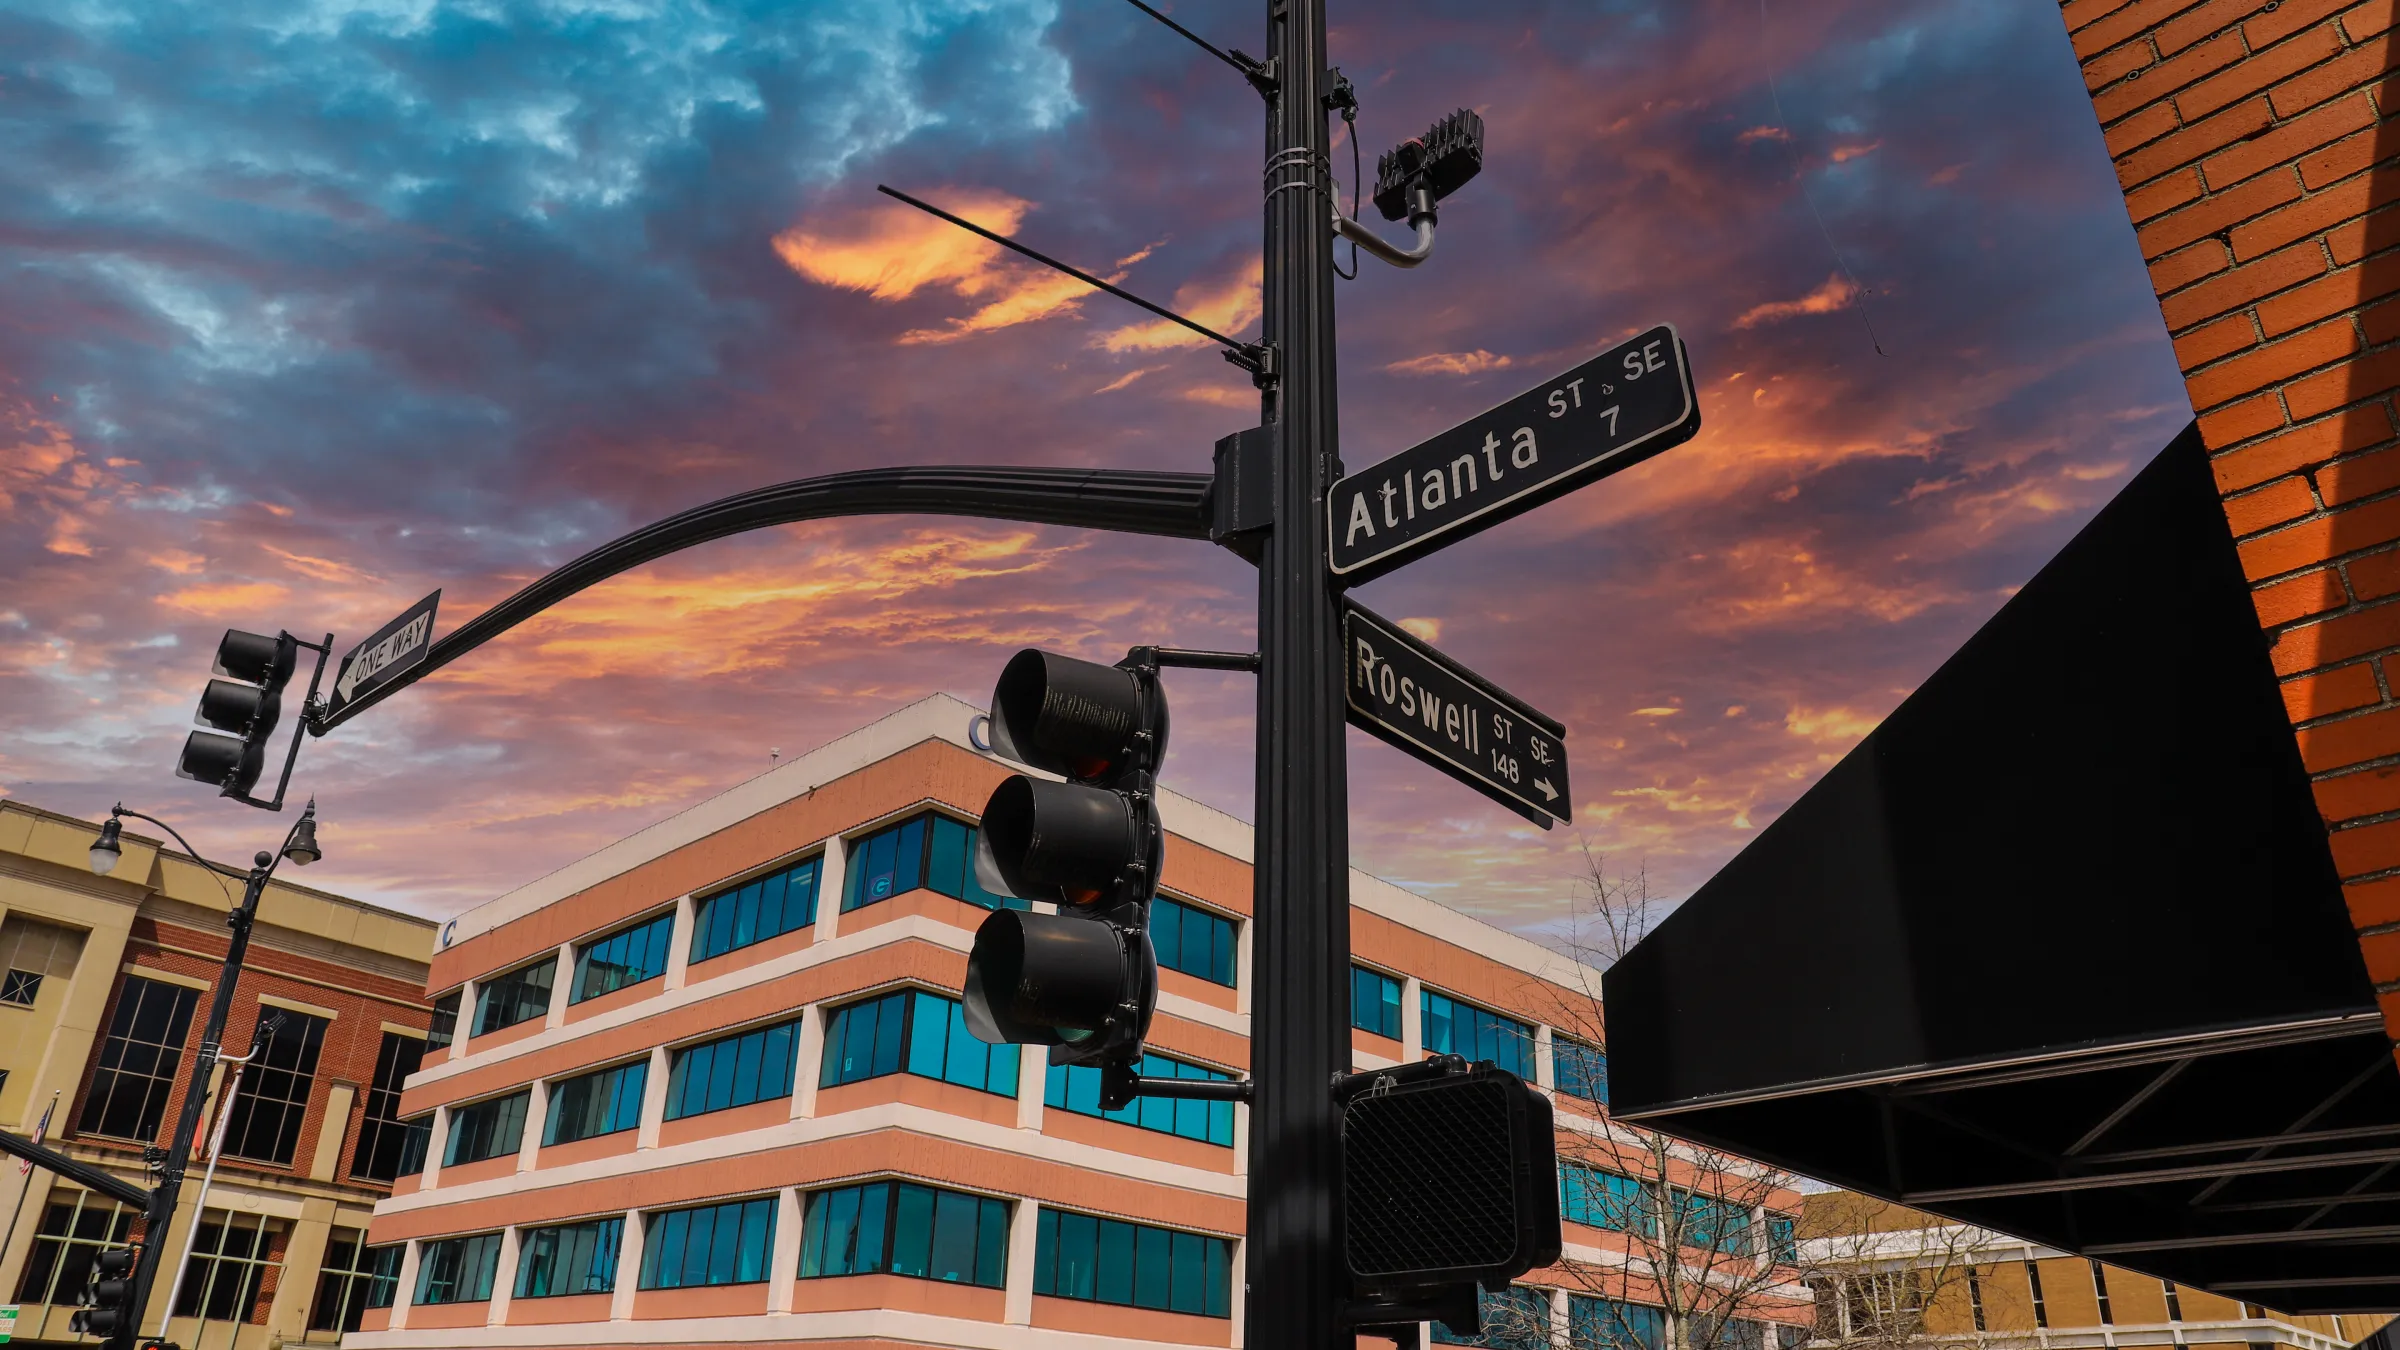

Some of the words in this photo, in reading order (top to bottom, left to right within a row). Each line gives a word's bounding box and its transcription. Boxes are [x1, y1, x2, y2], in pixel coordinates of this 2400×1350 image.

[1345, 426, 1539, 547] Atlanta
[1548, 378, 1584, 418] ST
[1623, 340, 1666, 381] SE
[1600, 405, 1620, 437] 7
[355, 642, 388, 683] ONE
[391, 616, 427, 660] WAY
[1356, 636, 1479, 755] Roswell
[1493, 714, 1513, 745] ST
[1530, 735, 1549, 764] SE
[1491, 748, 1520, 784] 148
[443, 919, 457, 947] C
